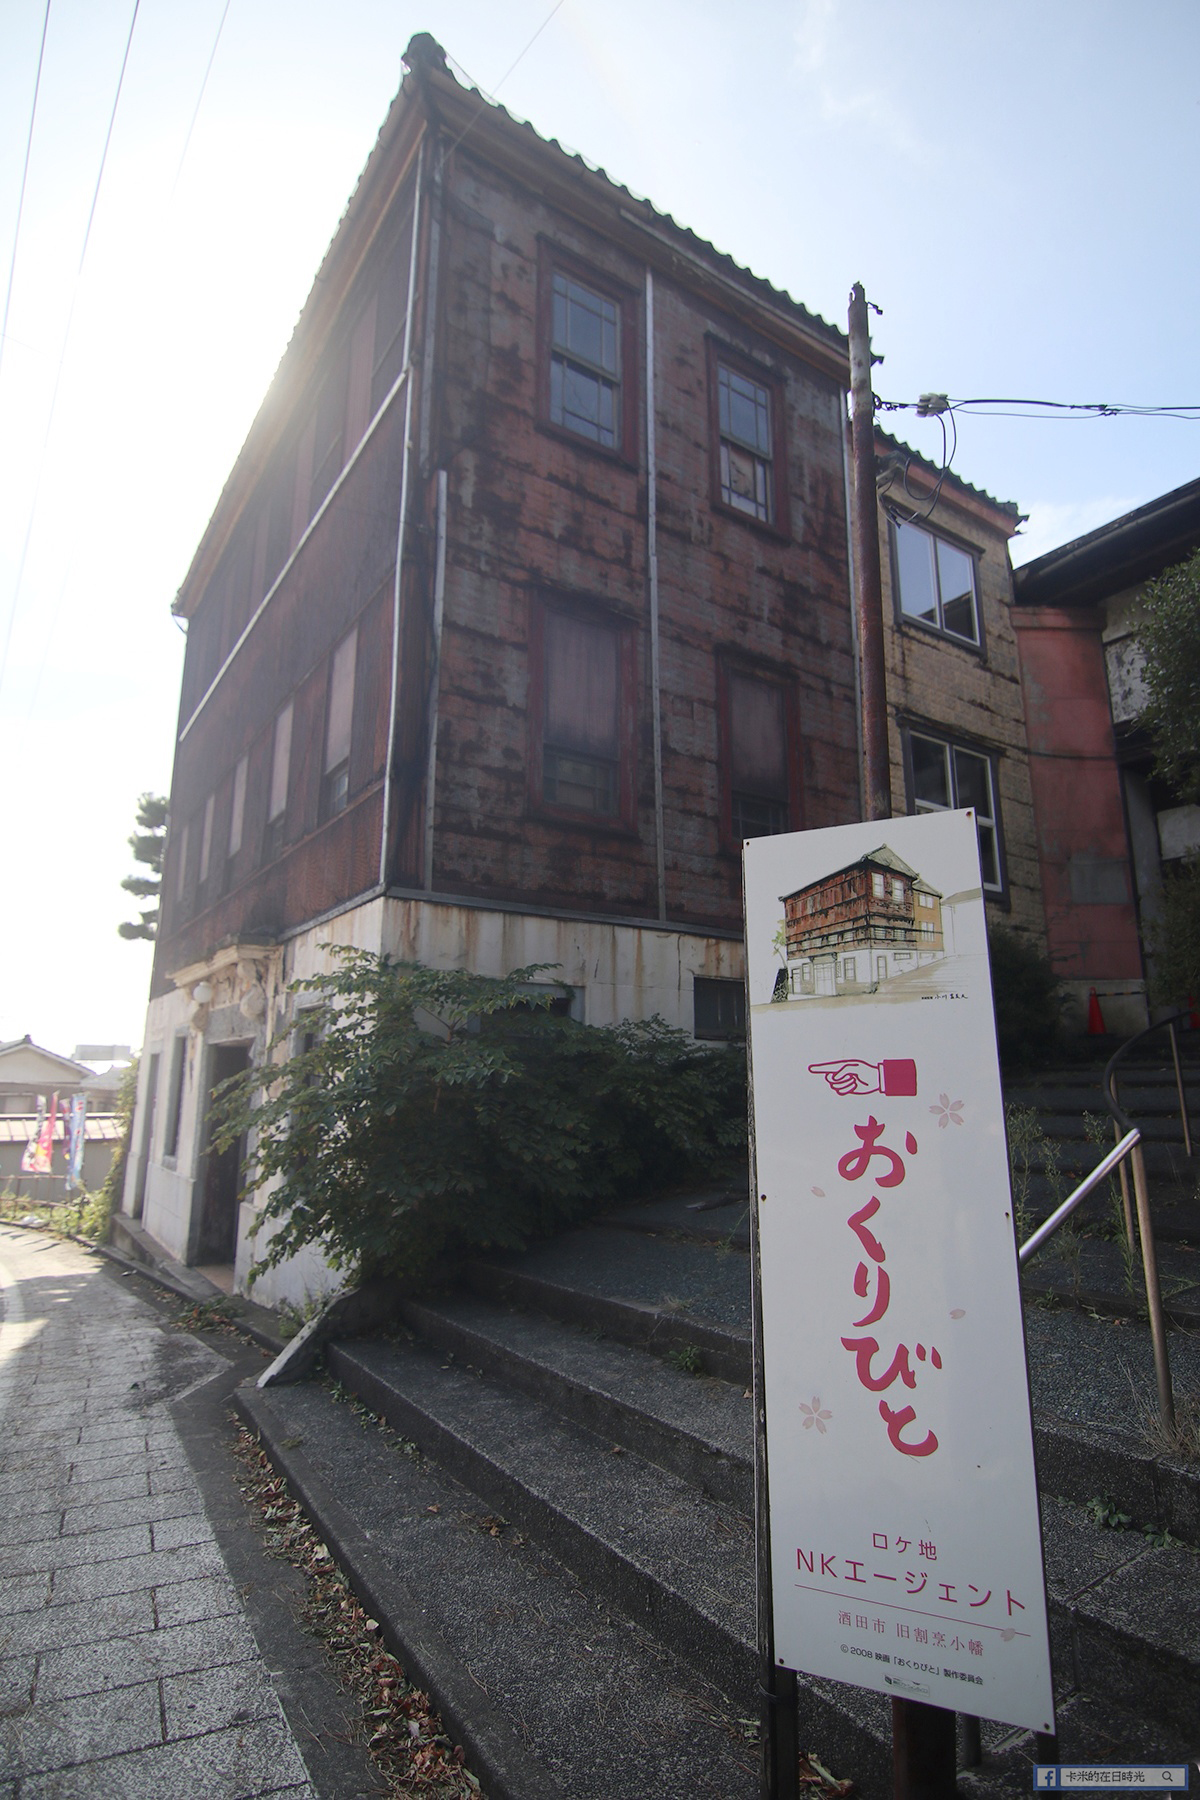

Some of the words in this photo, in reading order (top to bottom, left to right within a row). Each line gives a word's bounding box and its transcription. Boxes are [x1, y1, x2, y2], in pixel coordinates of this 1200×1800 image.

[837, 1115, 943, 1457] おくりびと
[872, 1532, 938, 1561] ロケ地
[796, 1548, 1026, 1617] NKエージェント
[838, 1609, 886, 1634] 酒田市
[895, 1622, 984, 1656] 旧割烹小幡
[850, 1646, 873, 1659] 2008
